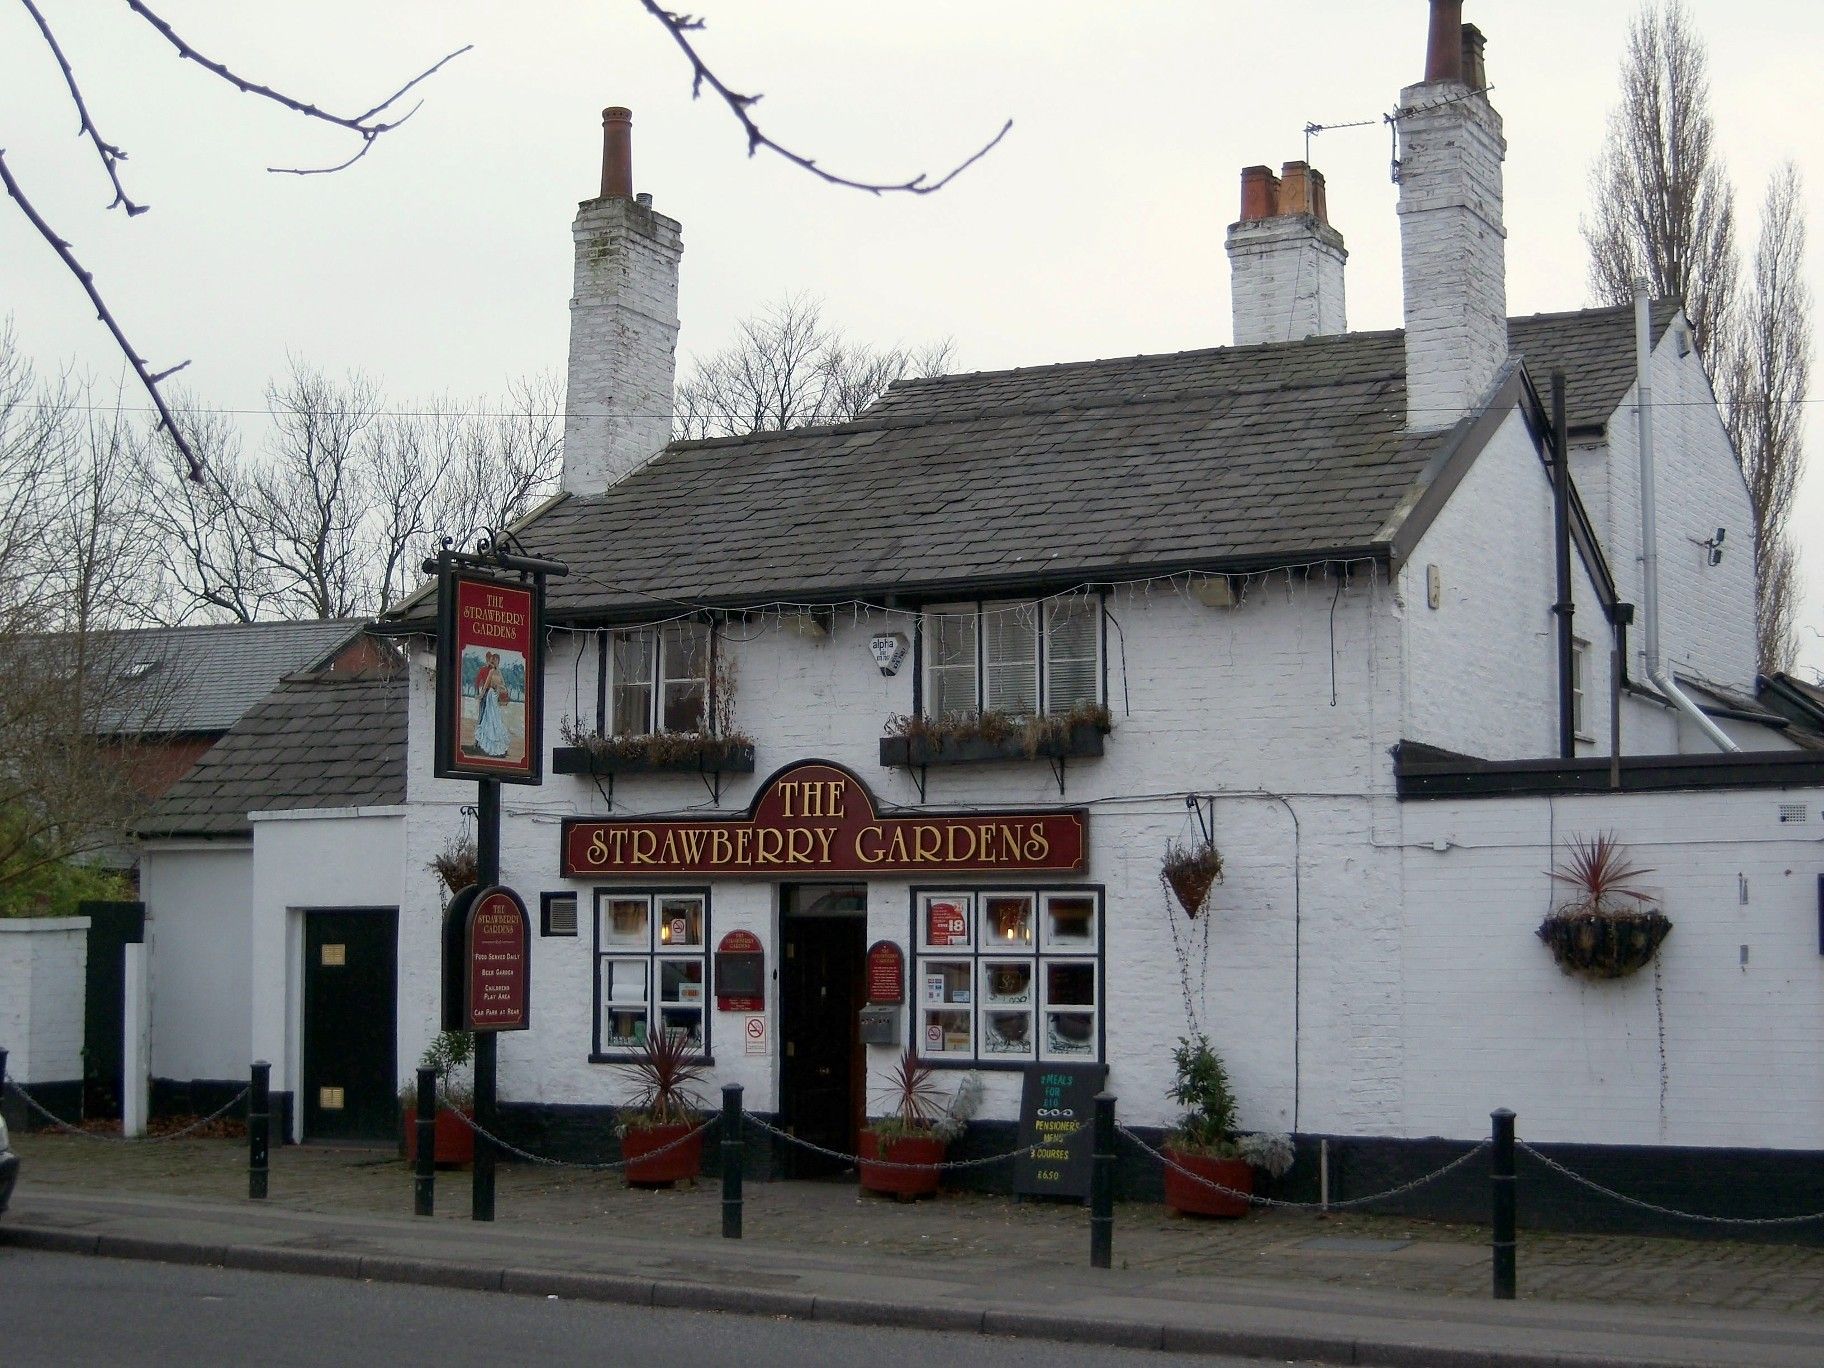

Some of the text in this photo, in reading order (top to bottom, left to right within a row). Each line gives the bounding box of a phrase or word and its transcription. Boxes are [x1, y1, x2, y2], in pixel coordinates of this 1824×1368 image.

[486, 594, 504, 608] THE
[463, 605, 525, 626] STRAWBERRY
[472, 622, 517, 640] GARDENS
[872, 639, 894, 651] alpha
[778, 779, 847, 819] THE
[586, 822, 1050, 866] STRAWBERRY GARDENS
[948, 919, 964, 932] 18
[1046, 1074, 1073, 1086] MEALS
[1045, 1086, 1060, 1097] FOR
[1037, 1148, 1069, 1160] COURSES
